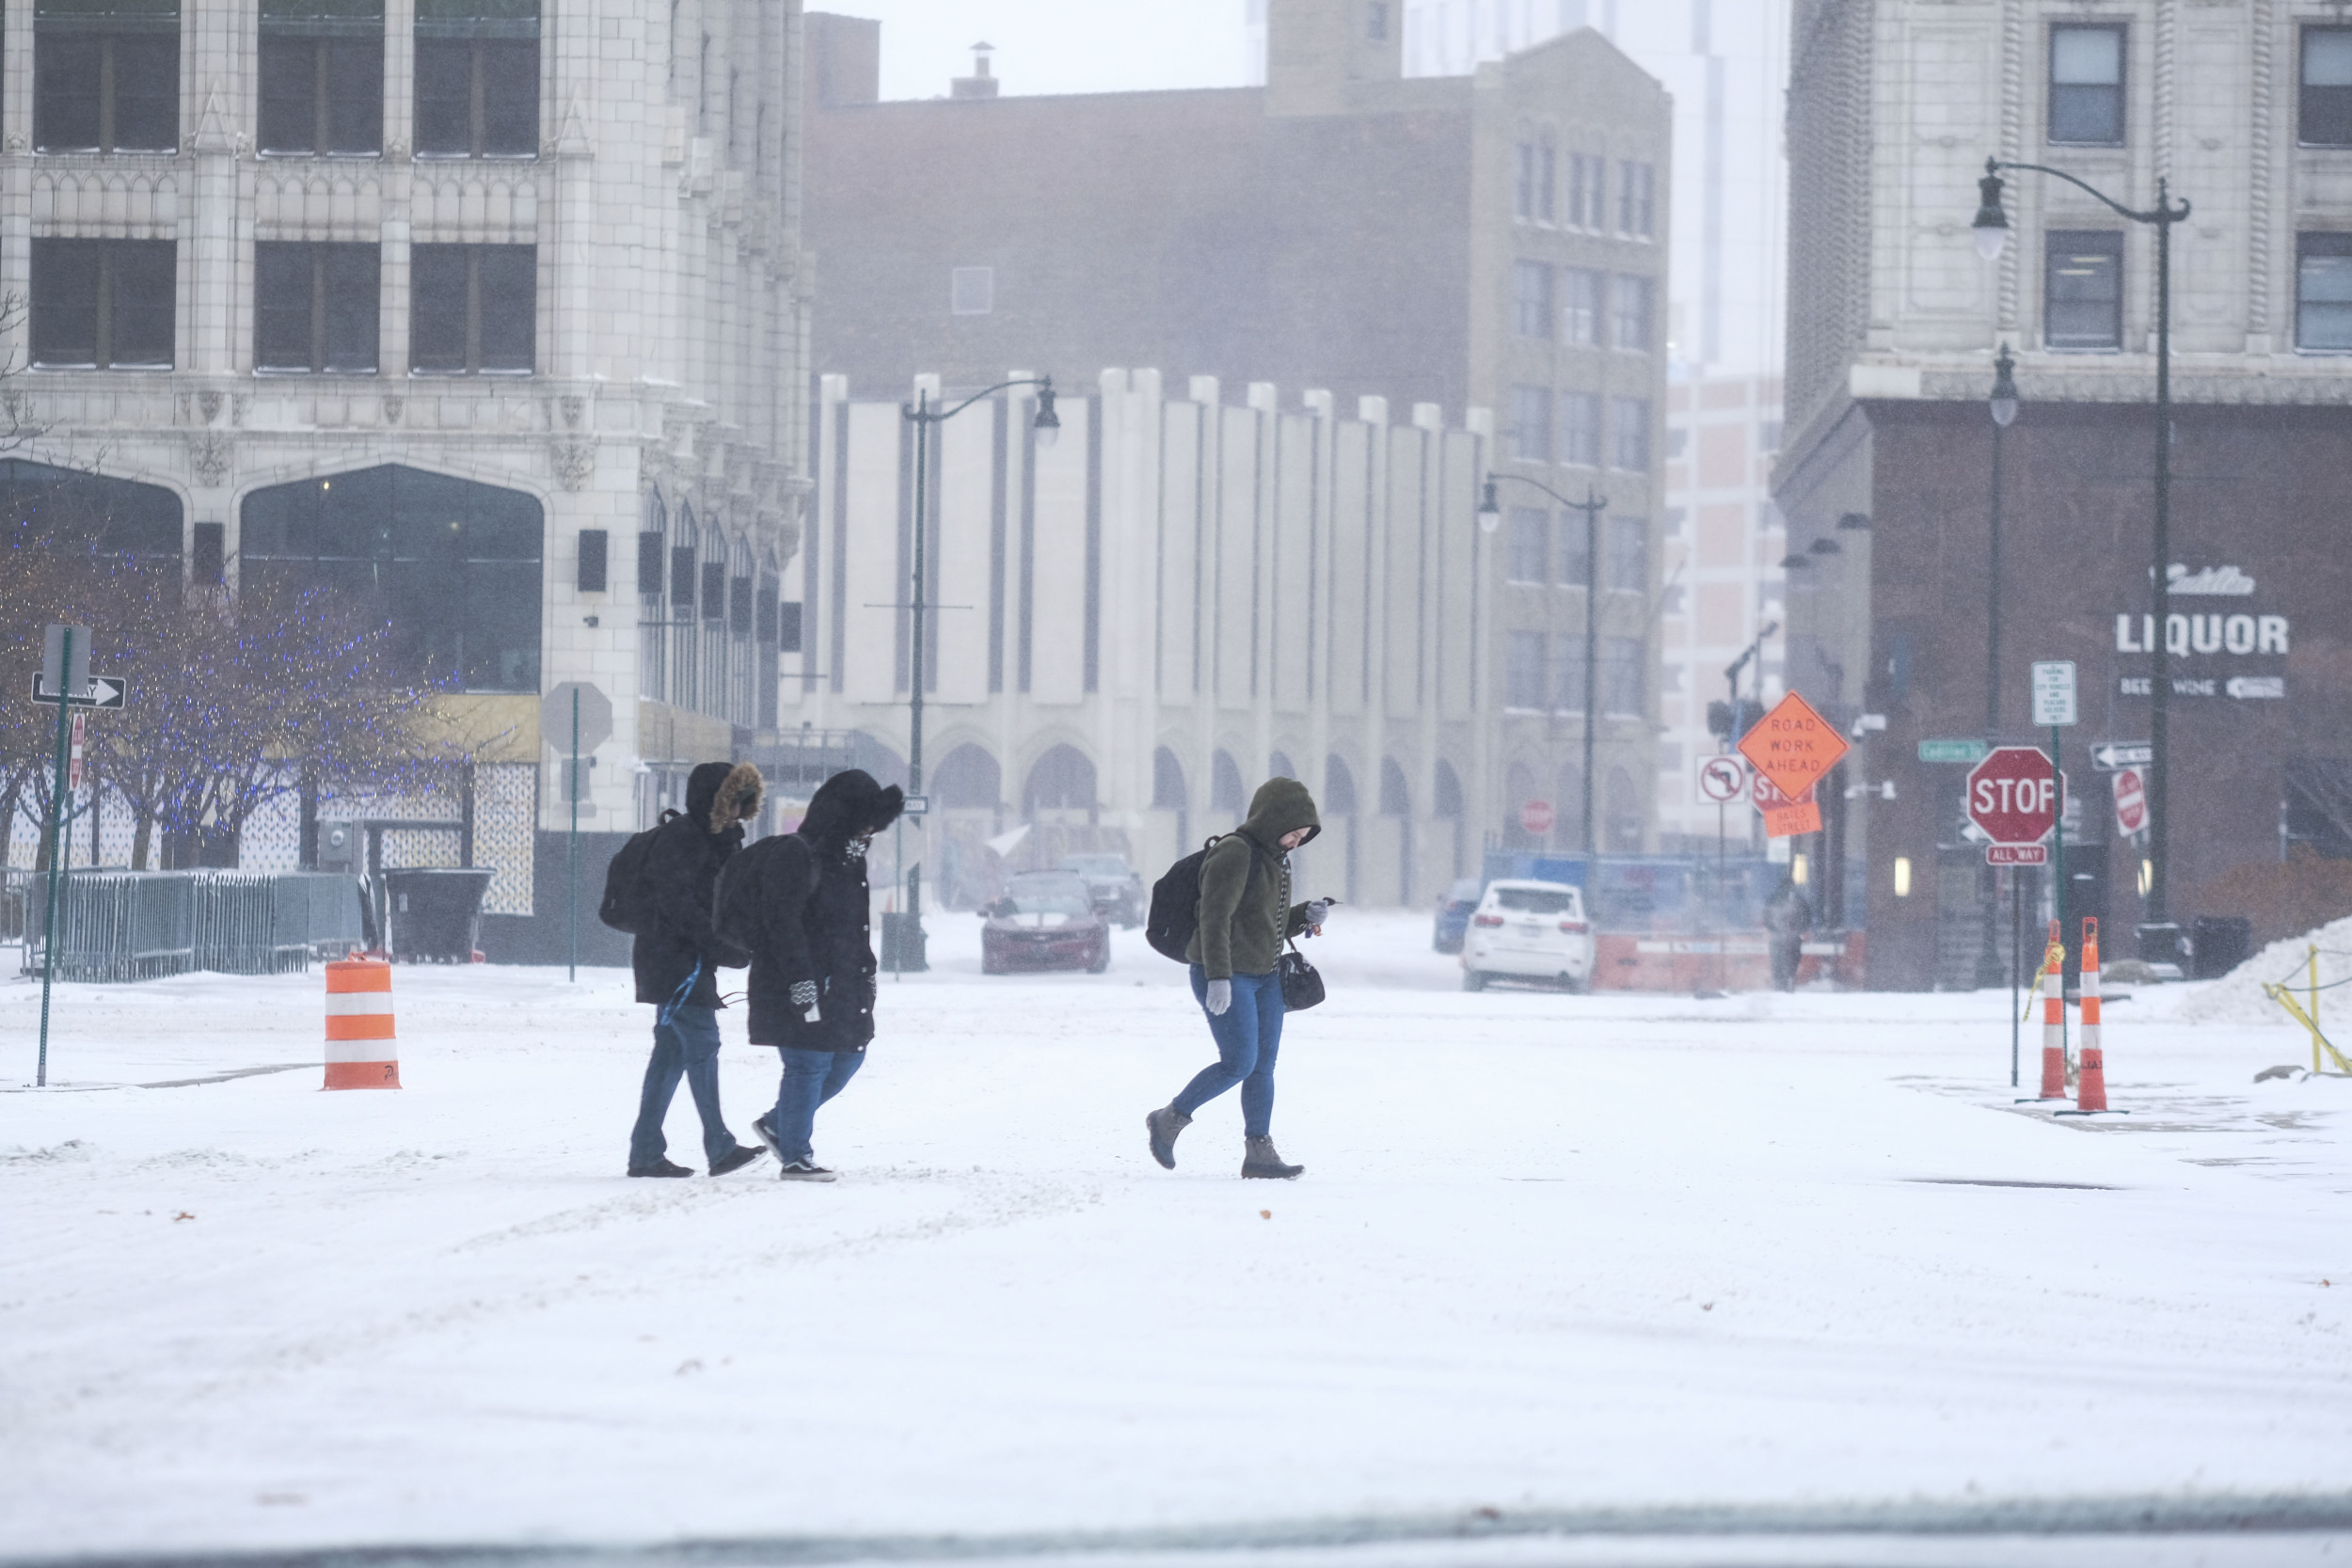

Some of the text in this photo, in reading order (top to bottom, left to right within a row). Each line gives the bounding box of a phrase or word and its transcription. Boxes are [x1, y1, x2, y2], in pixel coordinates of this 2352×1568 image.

[2117, 613, 2288, 657] LIQUOR
[1771, 719, 1815, 732] ROAD
[1771, 739, 1814, 752] WORK
[1766, 759, 1820, 772] AHEAD
[1974, 778, 2055, 814] STOP
[1993, 848, 2041, 861] ALL WAY
